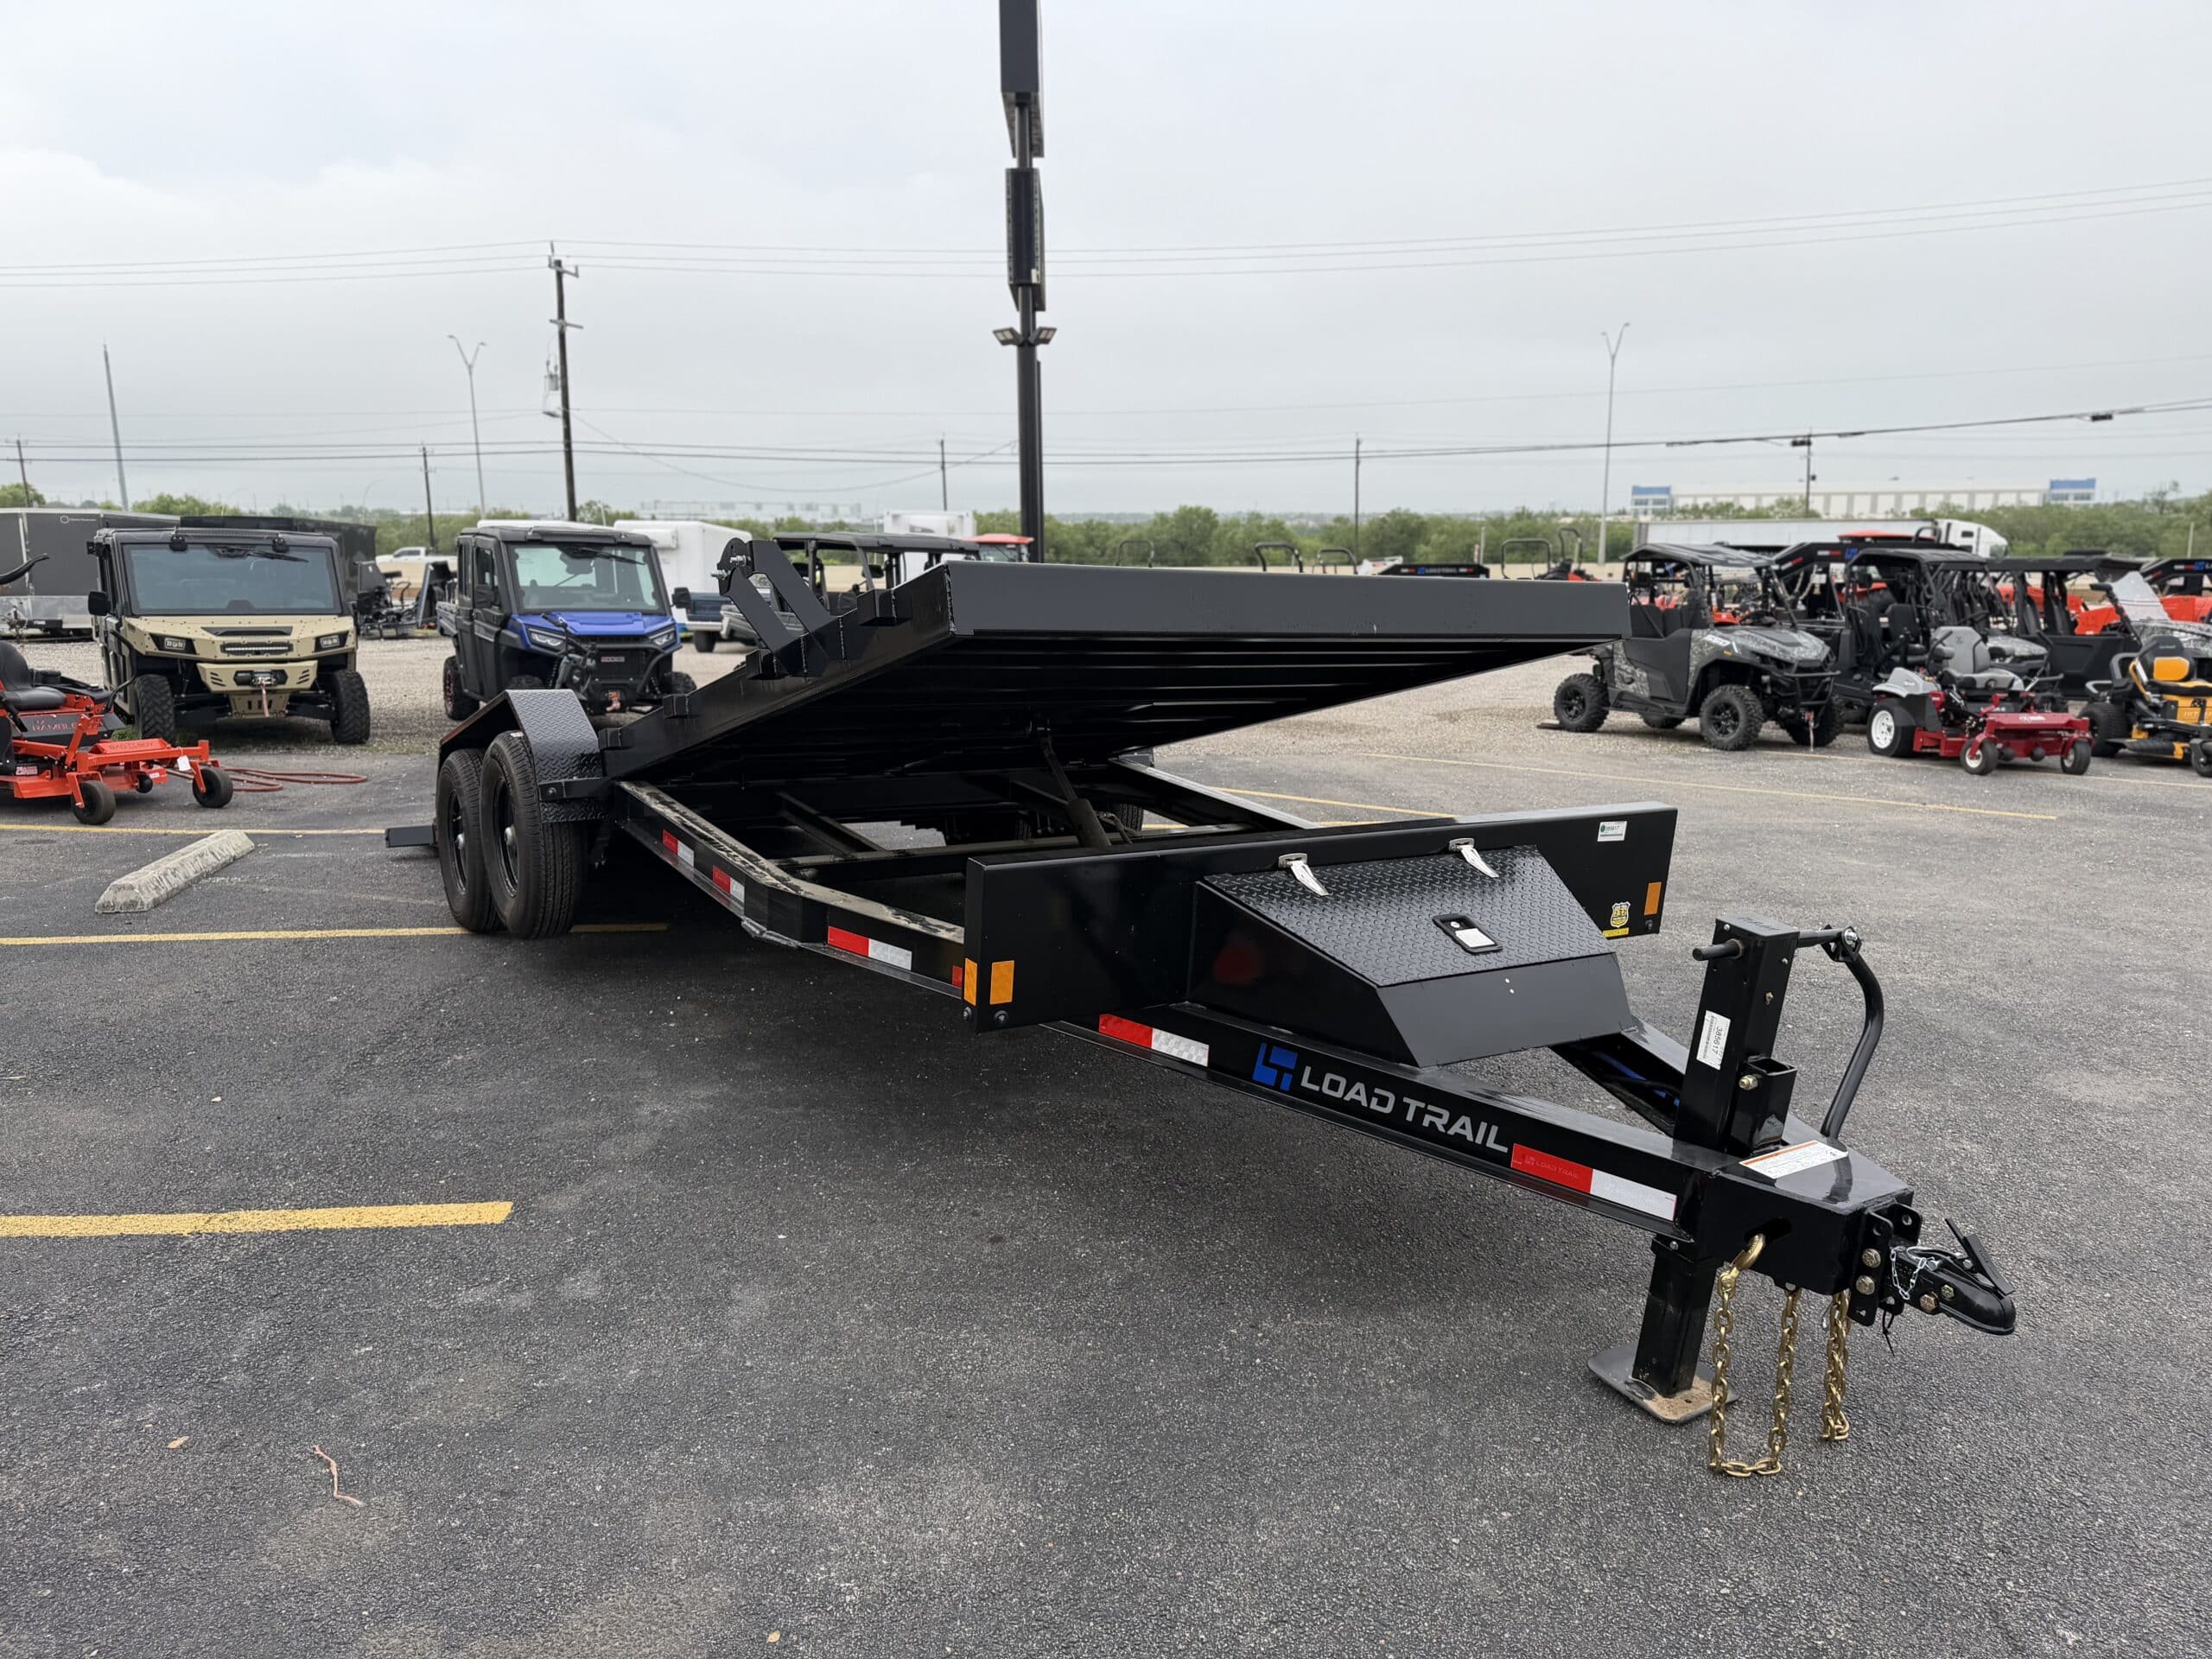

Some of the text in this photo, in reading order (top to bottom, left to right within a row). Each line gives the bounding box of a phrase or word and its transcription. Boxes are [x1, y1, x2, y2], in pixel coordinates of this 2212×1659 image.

[1712, 1027, 1723, 1054] 385617
[1300, 1065, 1509, 1154] LOAD TRAIL
